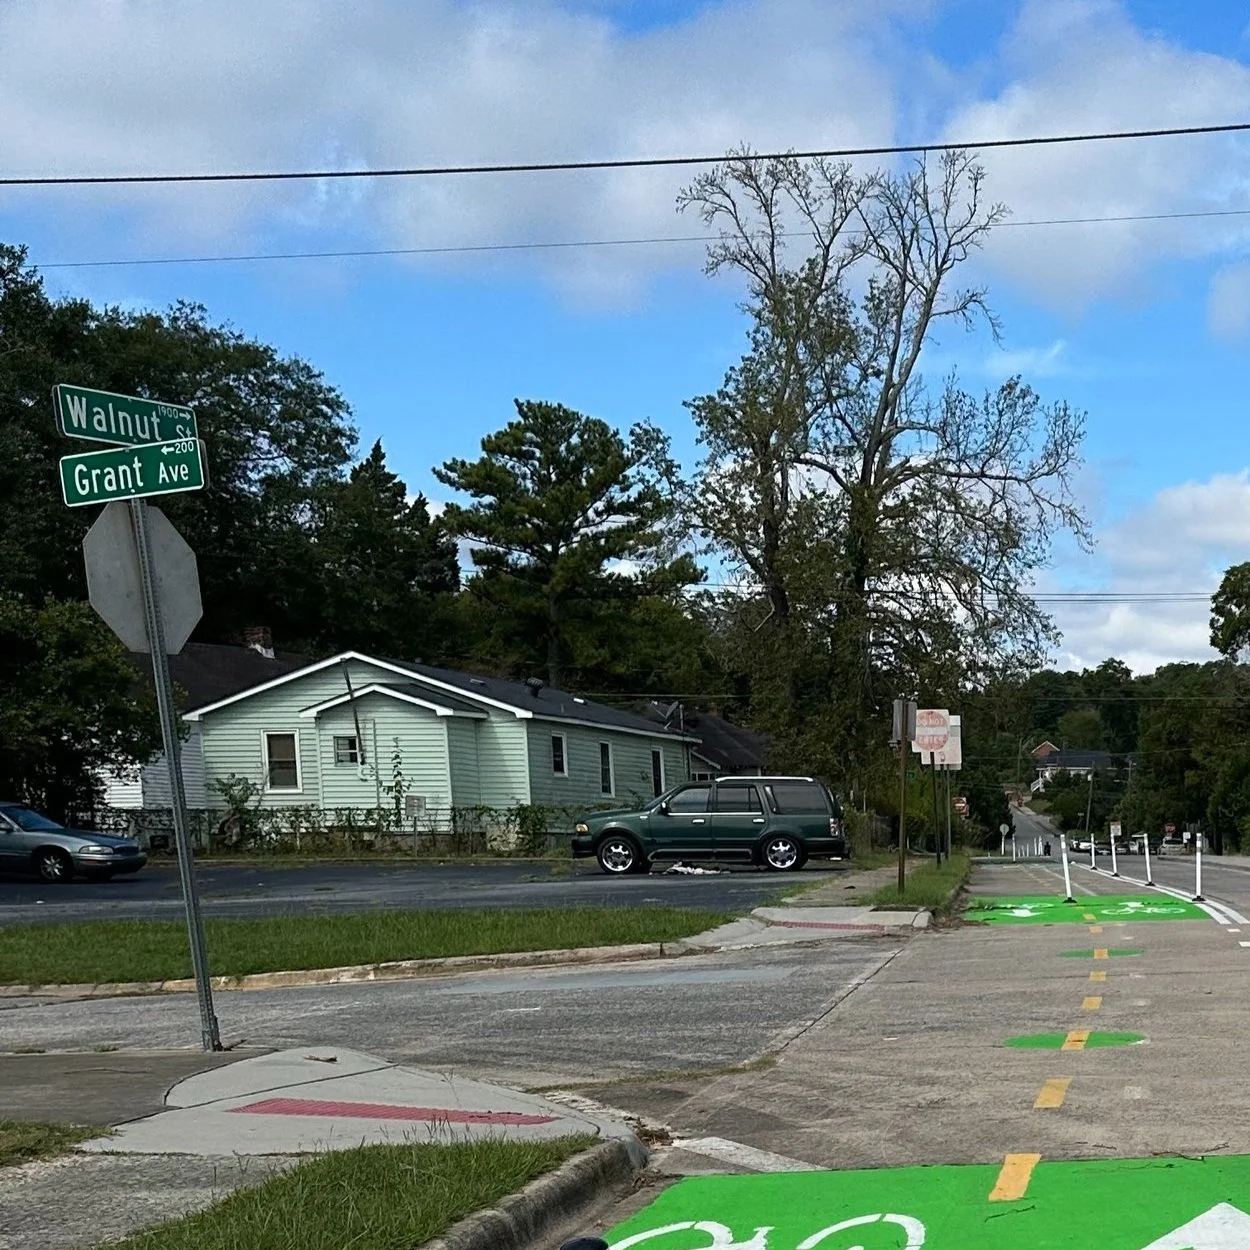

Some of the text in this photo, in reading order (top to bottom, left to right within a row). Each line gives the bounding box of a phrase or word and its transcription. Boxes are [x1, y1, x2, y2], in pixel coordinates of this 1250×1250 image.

[66, 394, 192, 442] Walnut St
[157, 405, 179, 419] 1900
[174, 441, 194, 454] 200
[74, 455, 189, 496] Grant Ave
